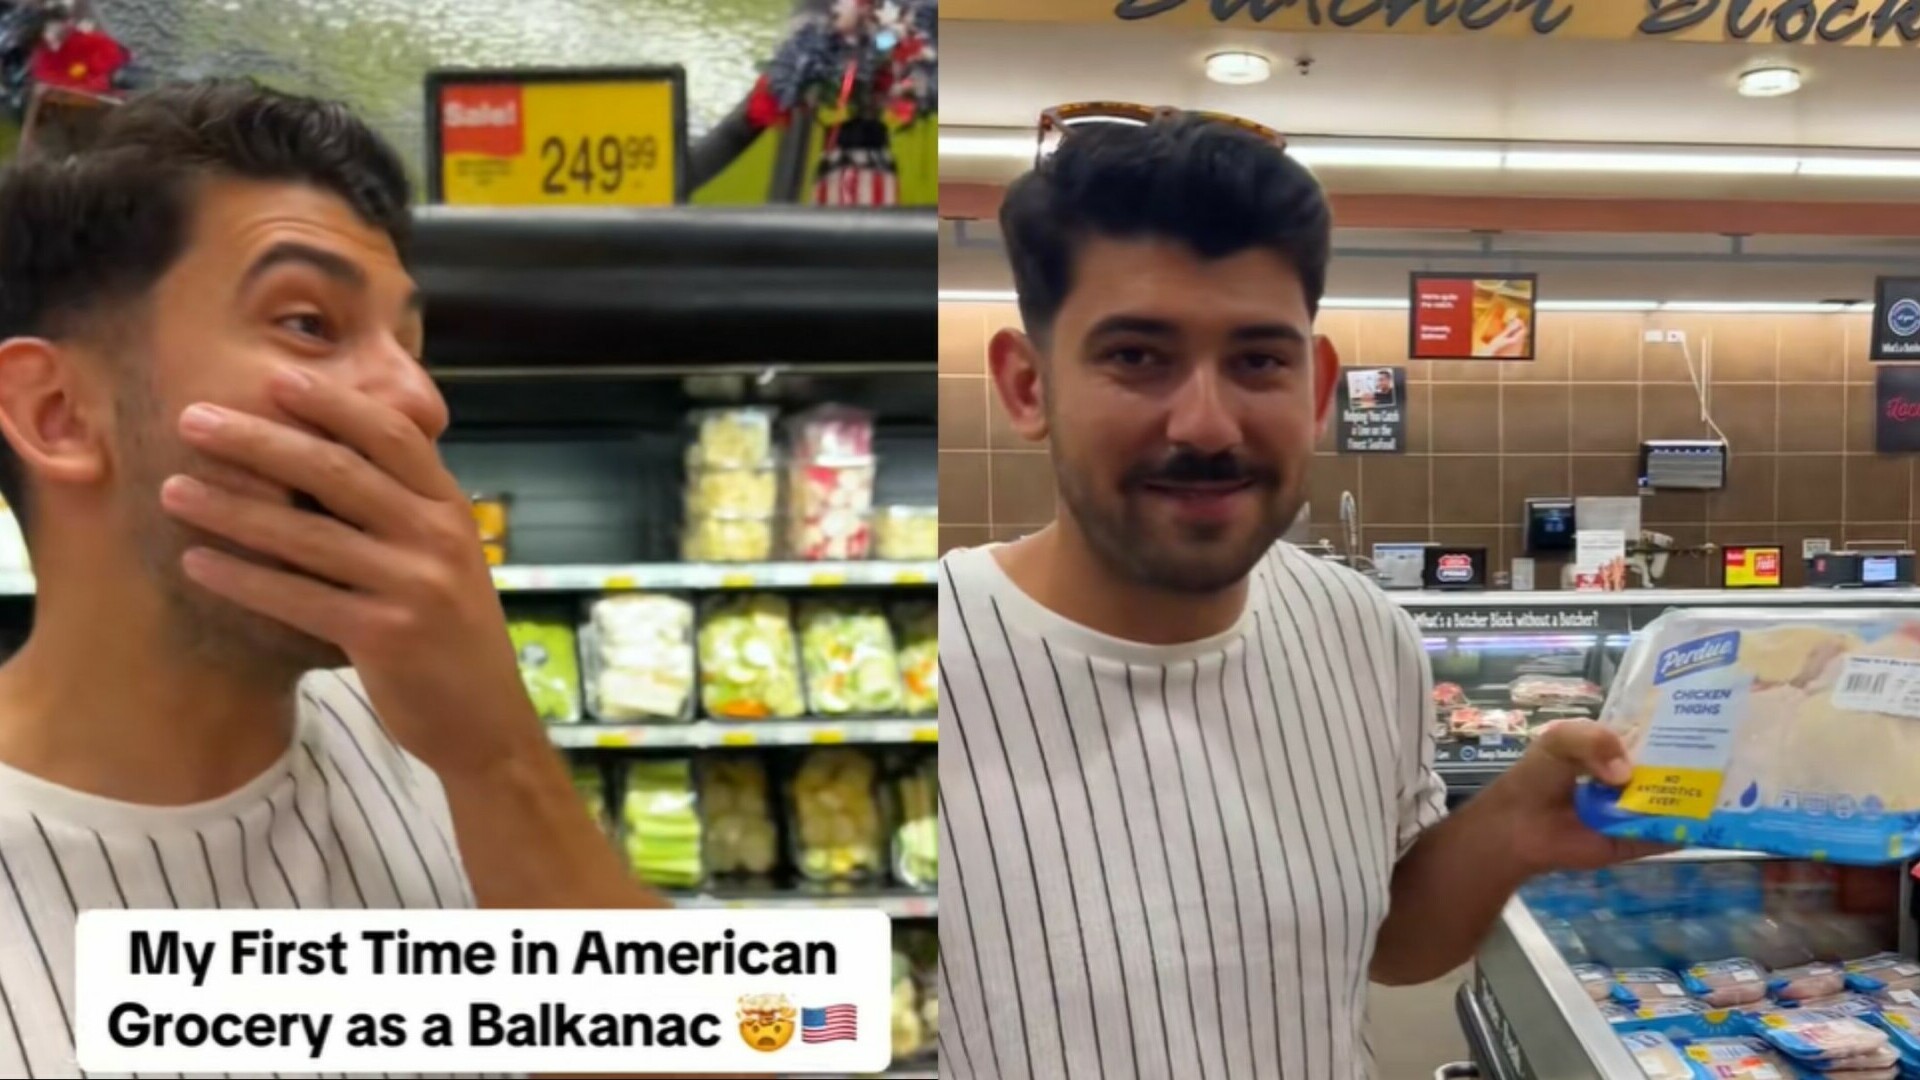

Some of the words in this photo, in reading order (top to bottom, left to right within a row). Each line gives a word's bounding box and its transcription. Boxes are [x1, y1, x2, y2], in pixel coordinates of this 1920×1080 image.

[1114, 0, 1573, 34] ucer
[443, 100, 517, 128] Sale!
[1453, 611, 1489, 628] Butcher
[1489, 611, 1513, 627] Block
[1515, 610, 1551, 627] without
[1672, 688, 1733, 701] CHICKEN
[1673, 703, 1721, 716] THIGHS
[1664, 774, 1681, 784] NO
[1636, 783, 1702, 798] ANTIBIOTICS
